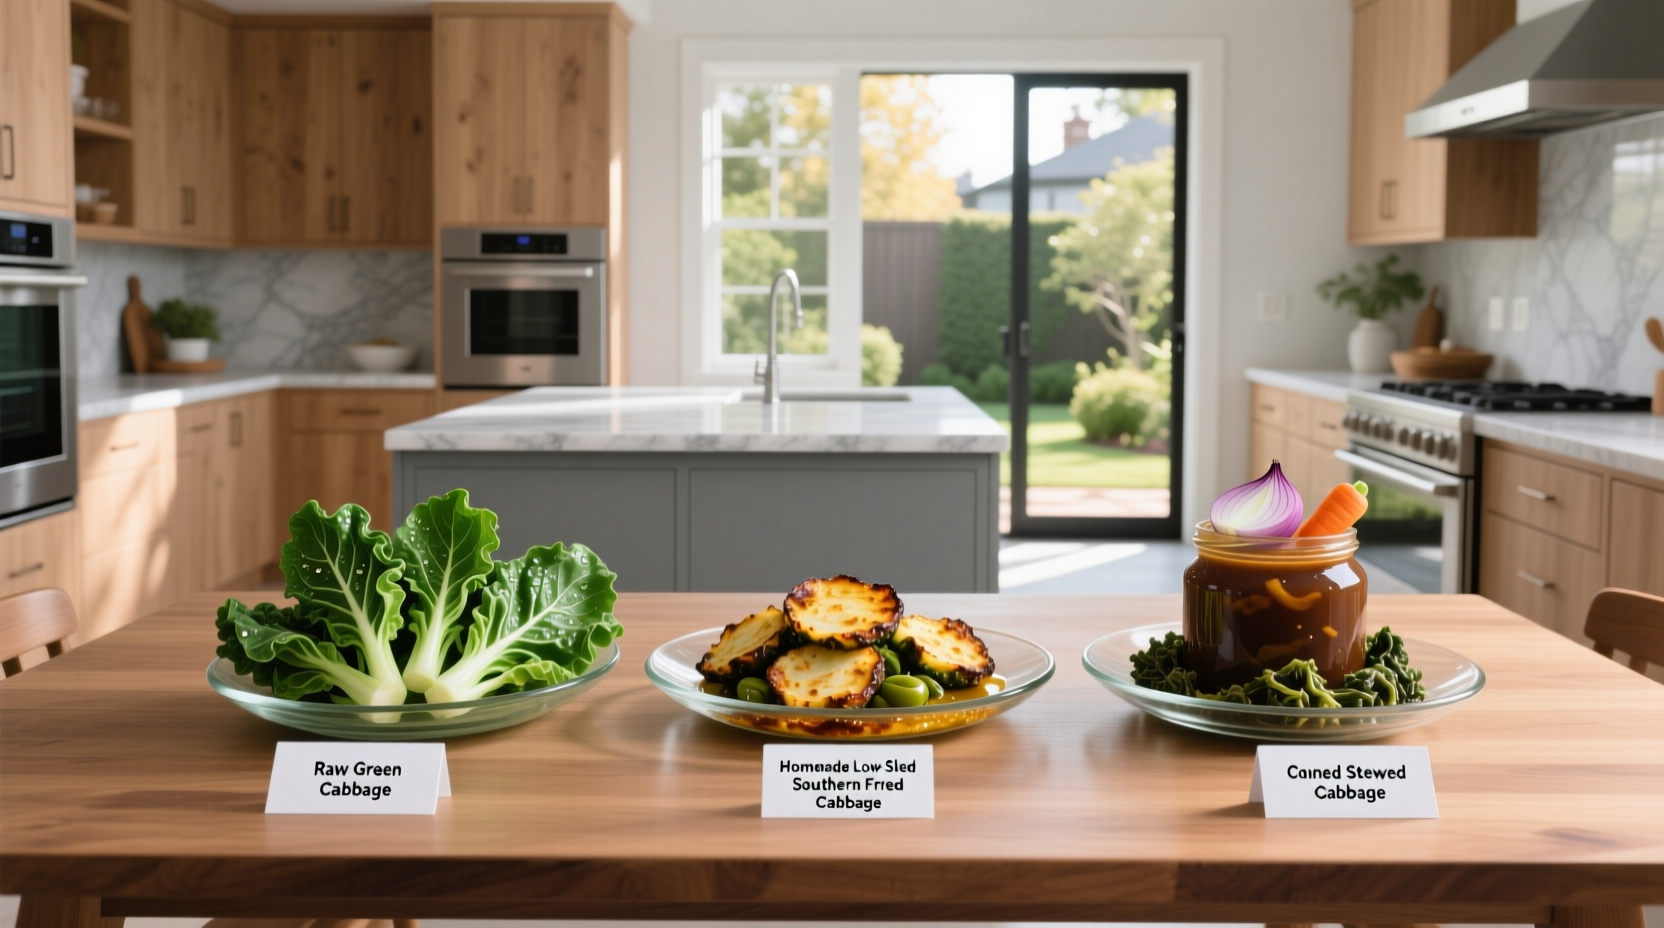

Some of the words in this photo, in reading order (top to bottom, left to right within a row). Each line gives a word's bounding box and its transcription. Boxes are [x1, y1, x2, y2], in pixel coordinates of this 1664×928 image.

[314, 761, 349, 776] Raw
[354, 761, 401, 776] Green
[853, 760, 881, 773] Low
[885, 759, 916, 773] Sled
[1346, 764, 1406, 779] Stewed
[320, 781, 391, 800] Cabbage
[793, 777, 861, 791] Southern
[1315, 784, 1386, 802] Cabbage
[816, 795, 882, 812] Cabbage
